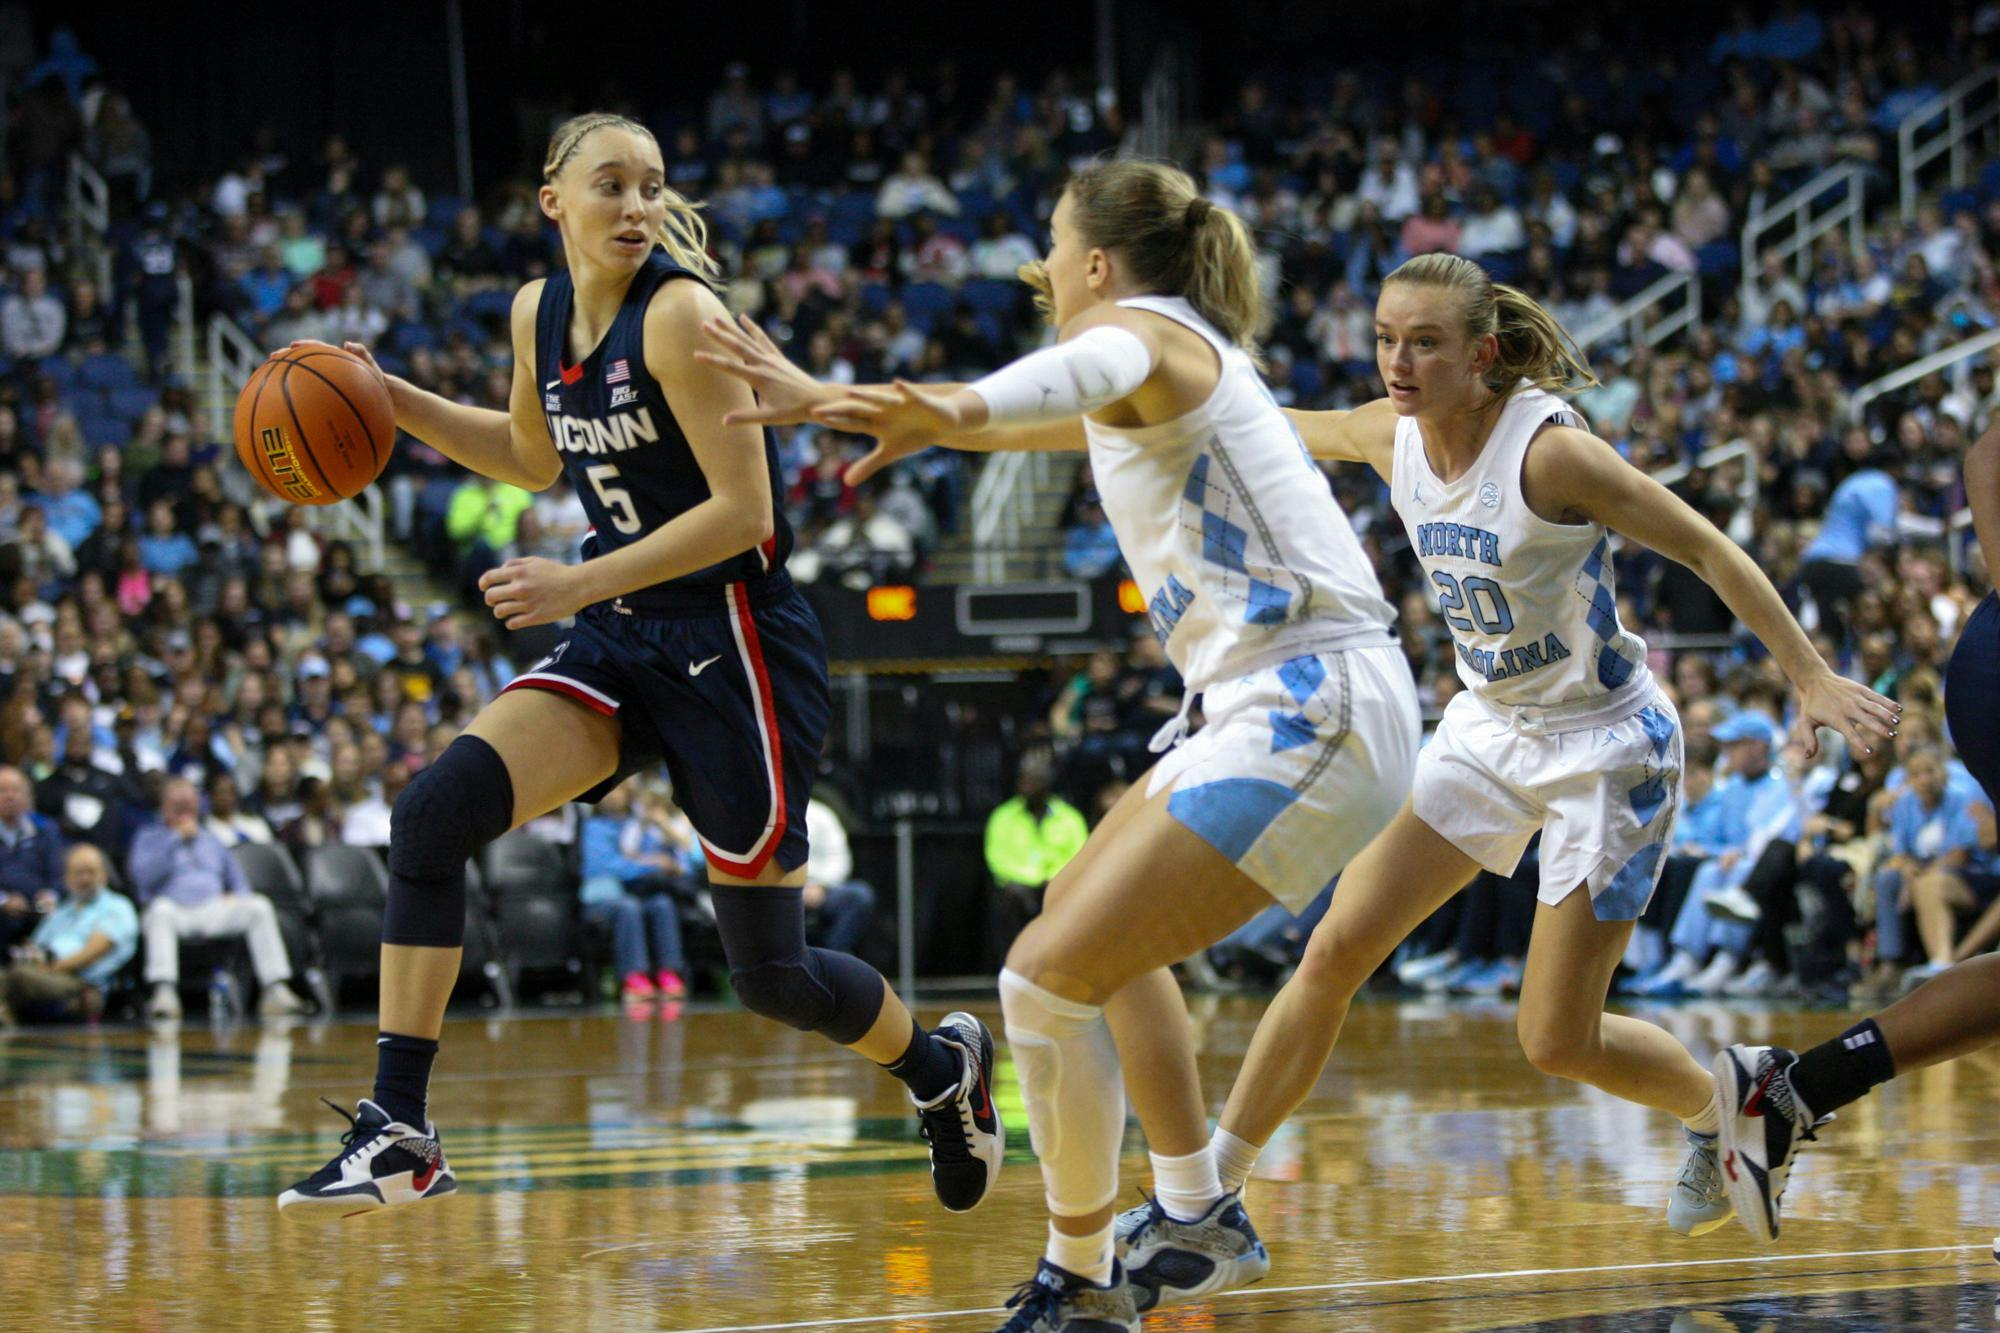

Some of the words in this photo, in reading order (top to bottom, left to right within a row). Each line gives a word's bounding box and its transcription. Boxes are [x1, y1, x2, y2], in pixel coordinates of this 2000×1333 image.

[611, 390, 639, 403] EAST
[612, 385, 631, 395] BIG
[261, 427, 313, 498] ELITE
[585, 464, 642, 534] 5
[1417, 522, 1502, 567] NORTH
[1431, 570, 1514, 635] 20
